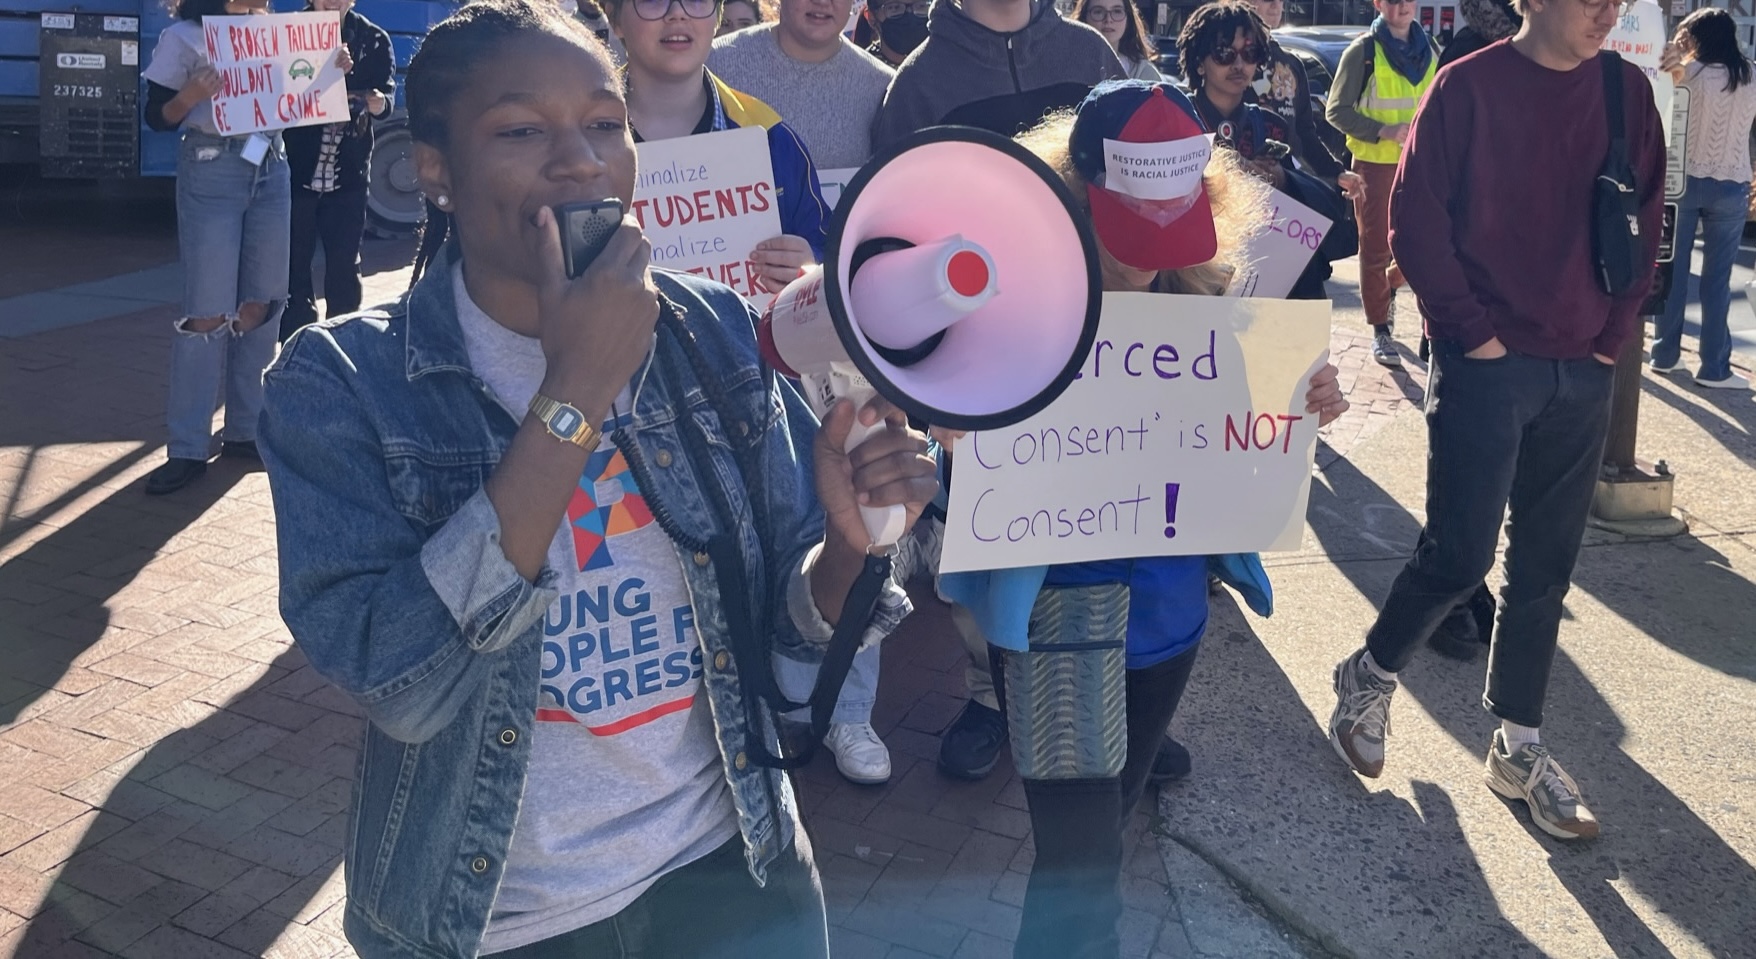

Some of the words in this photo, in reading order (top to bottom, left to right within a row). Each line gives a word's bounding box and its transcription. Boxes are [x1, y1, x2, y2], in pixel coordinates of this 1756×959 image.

[204, 22, 222, 62] MY
[229, 24, 279, 62] BROKEN
[285, 22, 339, 53] TAILLIGHT
[54, 84, 102, 98] 237325
[215, 102, 231, 132] BE
[253, 98, 267, 127] A
[278, 90, 327, 123] CRIME
[1112, 153, 1177, 167] RESTORATIVE
[1178, 148, 1206, 164] JUSTICE
[1121, 167, 1129, 176] IS
[1132, 170, 1168, 179] RACIAL
[1170, 163, 1199, 178] JUSTICE
[649, 235, 727, 263] nalize
[1073, 330, 1219, 380] rced
[1178, 419, 1209, 450] is
[1224, 411, 1303, 454] NOT
